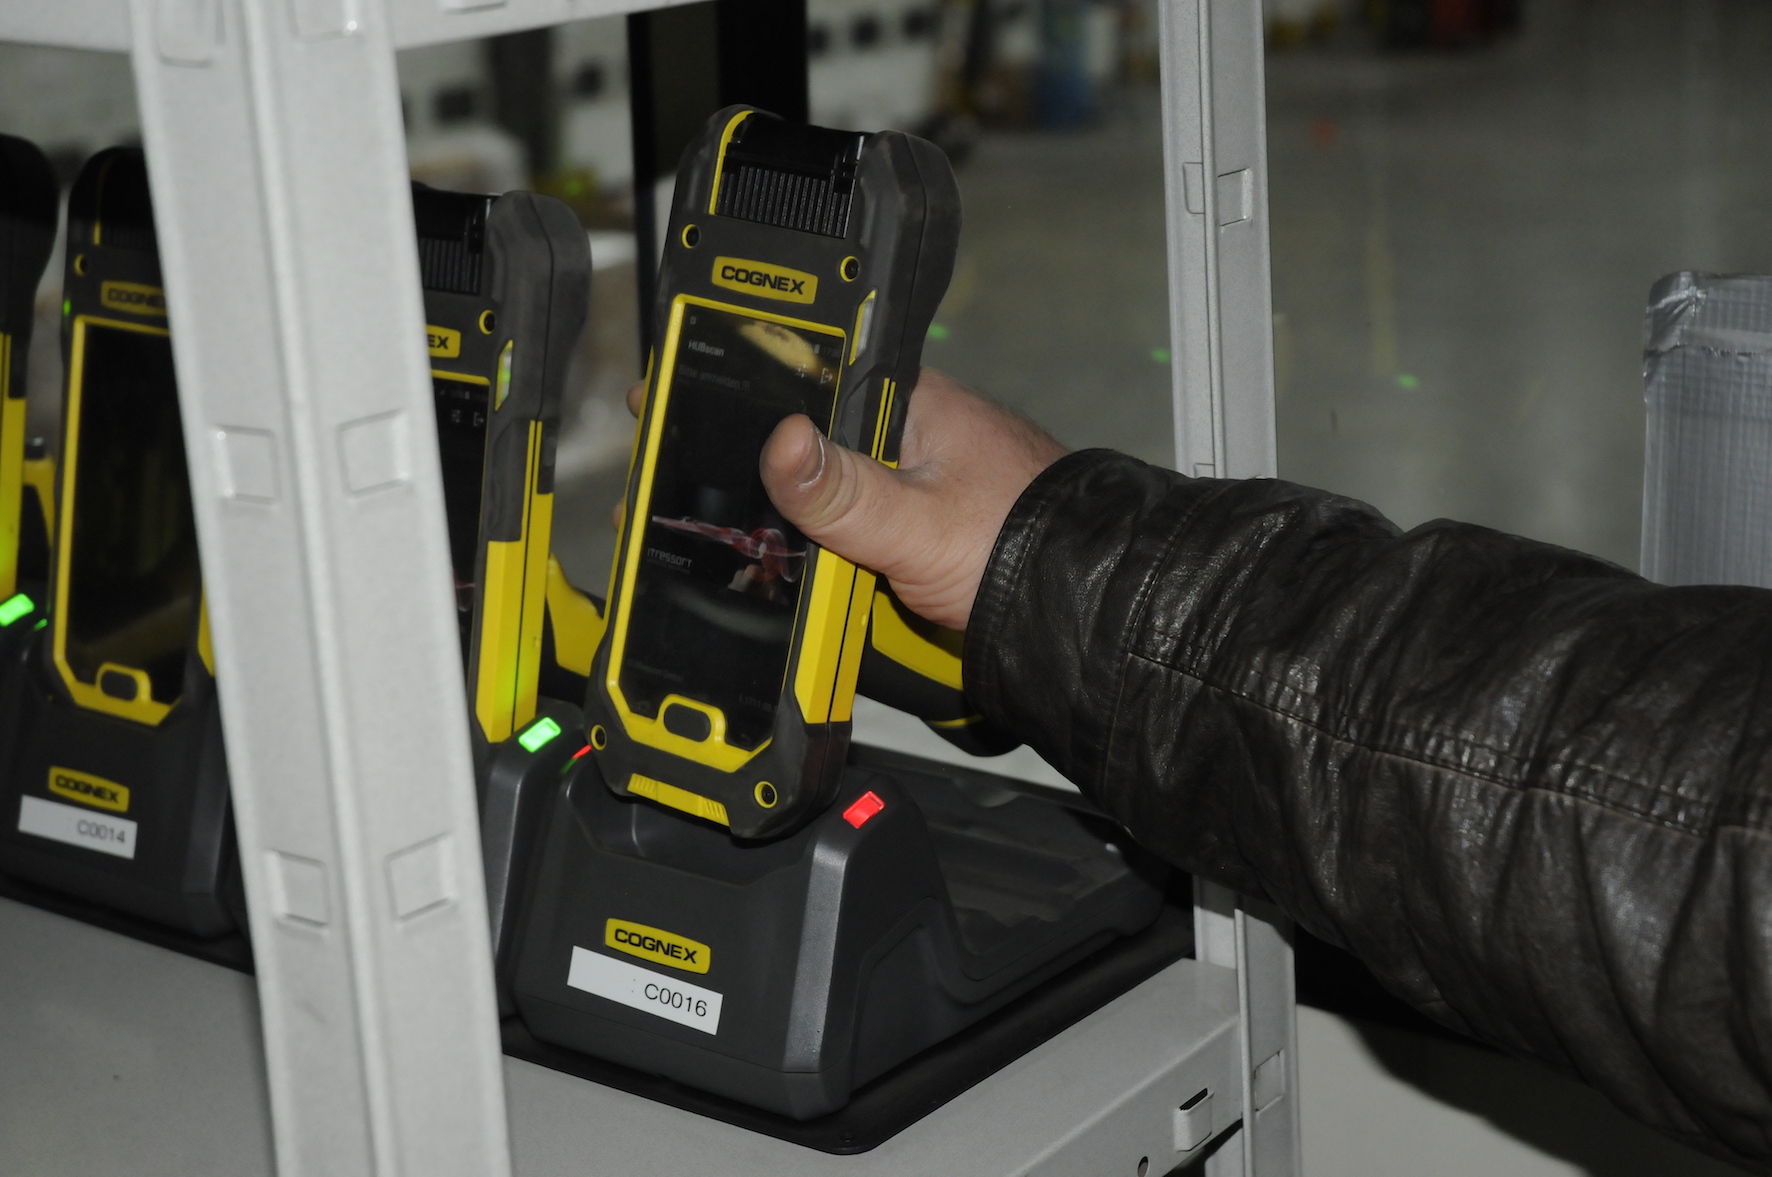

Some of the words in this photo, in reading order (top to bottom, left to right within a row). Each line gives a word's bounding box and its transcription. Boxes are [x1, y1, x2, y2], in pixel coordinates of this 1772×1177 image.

[721, 265, 805, 295] COGNEX
[108, 287, 165, 307] COGNE
[426, 334, 449, 350] EX
[688, 340, 725, 357] HUBscan
[55, 775, 119, 803] COGNEX
[77, 820, 126, 844] C0014
[614, 928, 697, 964] COGNEX
[644, 983, 708, 1017] C0016
